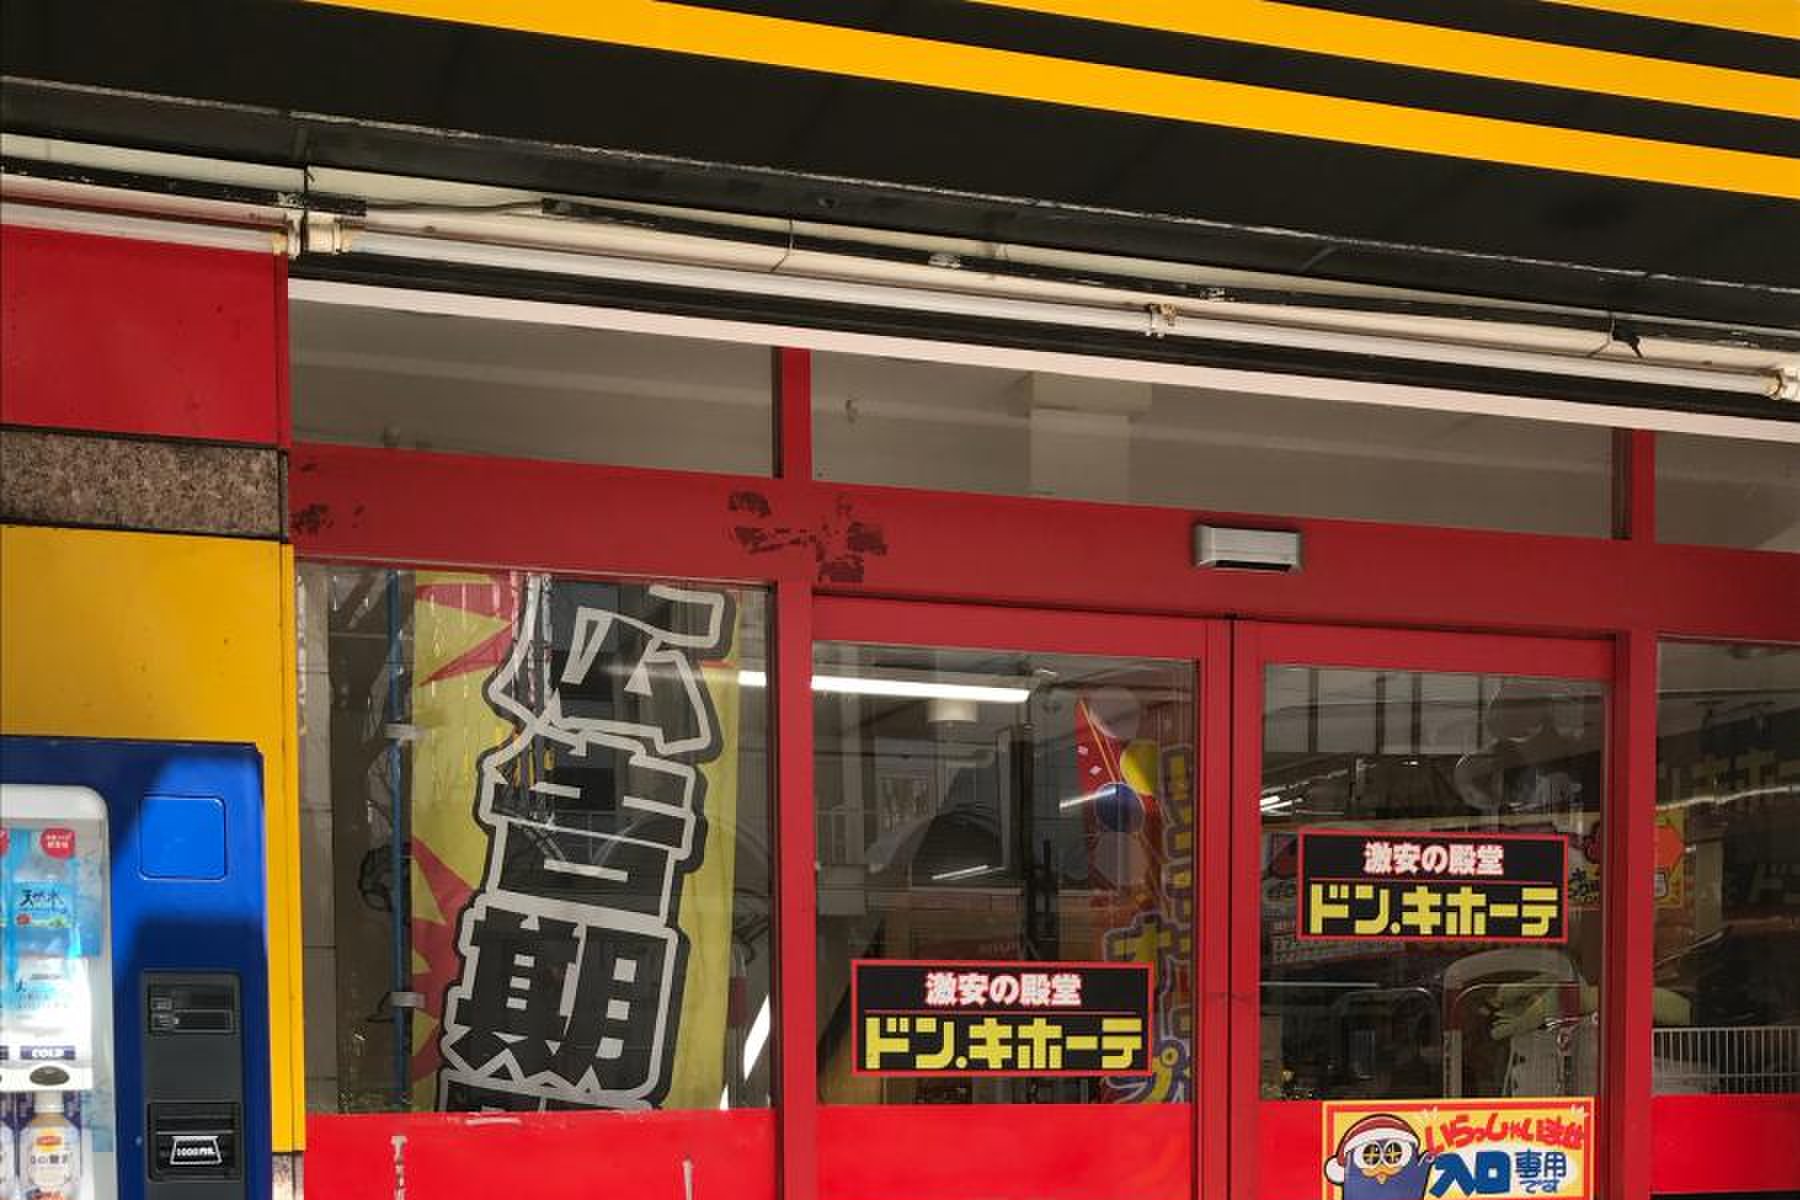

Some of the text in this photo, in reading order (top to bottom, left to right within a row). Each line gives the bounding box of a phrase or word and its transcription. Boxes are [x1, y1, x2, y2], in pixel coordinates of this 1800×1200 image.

[440, 576, 734, 1111] 広告期
[1363, 841, 1505, 877] 激安の殿堂
[924, 971, 1083, 1008] 激安の殿堂
[1429, 1149, 1568, 1198] 入口 専用
[1518, 1179, 1560, 1195] です
